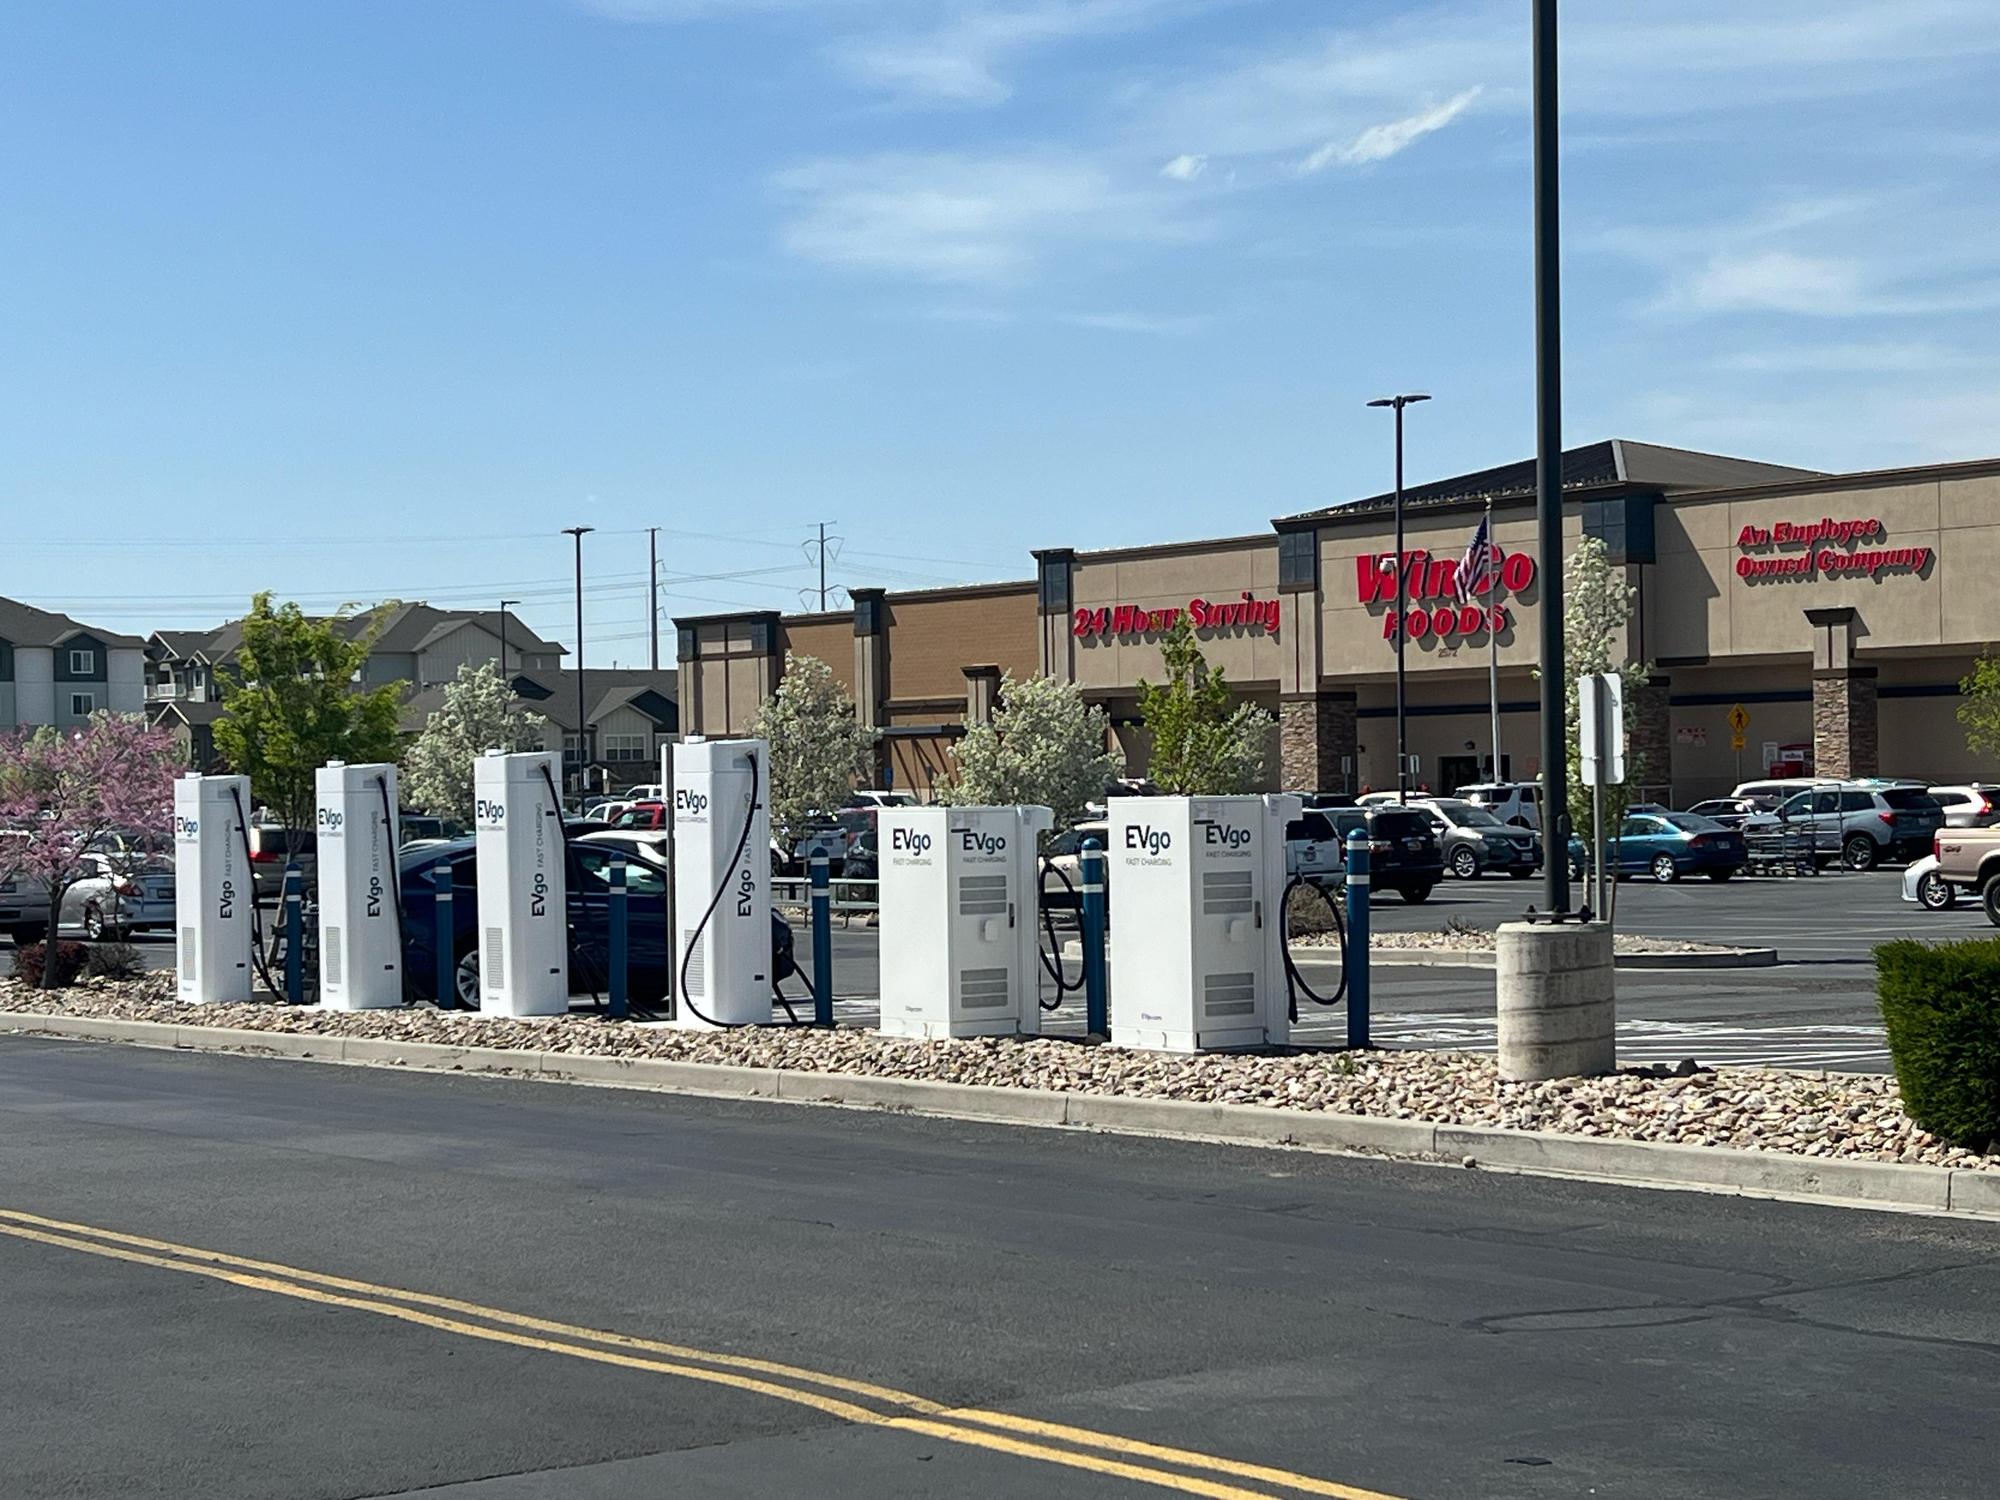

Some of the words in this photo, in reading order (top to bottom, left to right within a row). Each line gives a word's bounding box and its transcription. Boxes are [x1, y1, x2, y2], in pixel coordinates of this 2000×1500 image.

[1737, 525, 1769, 545] An
[1773, 518, 1880, 548] Employee
[1736, 551, 1812, 578] Owned
[1816, 548, 1930, 575] Company
[1073, 607, 1107, 637] 24
[1112, 605, 1181, 633] Hour
[477, 800, 505, 823] EVgo
[676, 789, 708, 815] EVgo
[177, 816, 199, 837] EVgo
[319, 808, 343, 830] EVgo
[893, 828, 931, 856] EVgo
[963, 832, 1006, 855] EVgo
[1125, 825, 1171, 856] EVgo
[1205, 824, 1251, 849] EVgo
[220, 880, 235, 918] EVgo
[367, 876, 383, 917] EVgo
[531, 873, 548, 917] EVgo
[737, 869, 755, 916] EVgo
